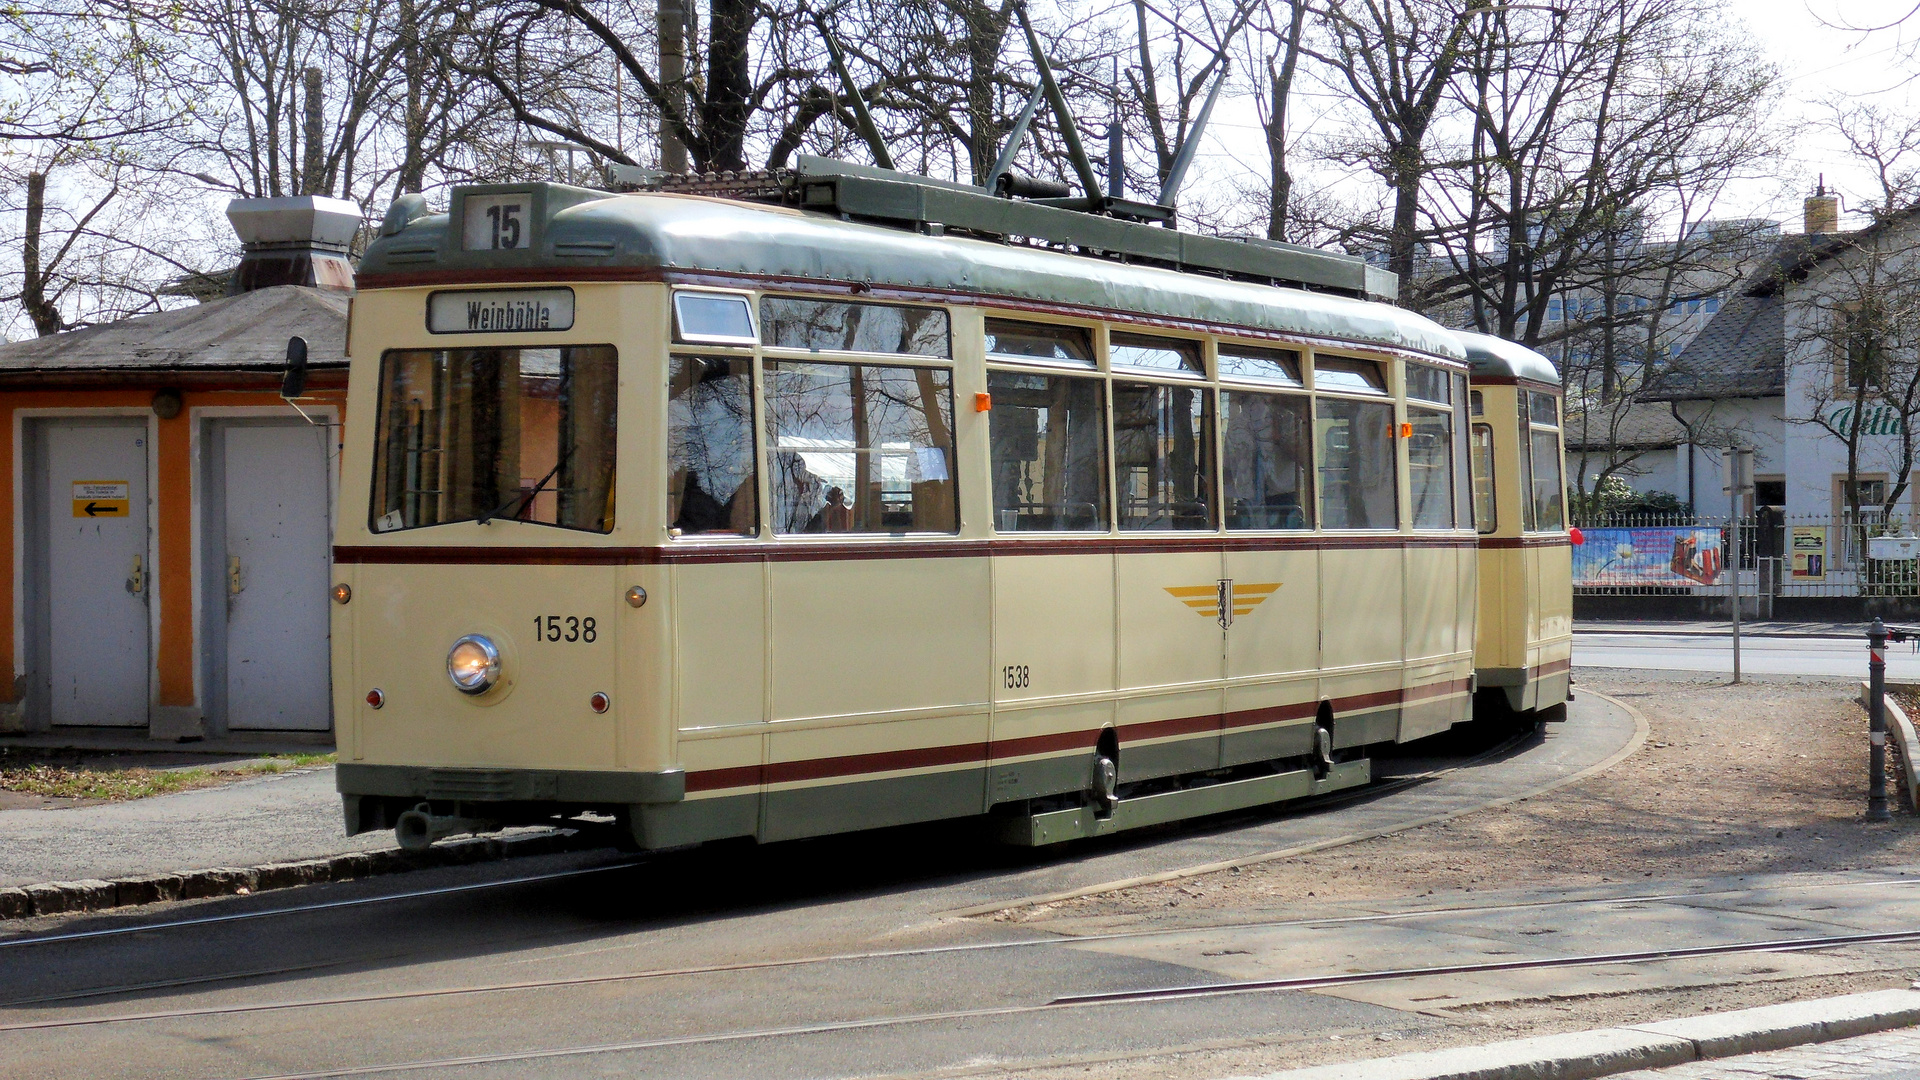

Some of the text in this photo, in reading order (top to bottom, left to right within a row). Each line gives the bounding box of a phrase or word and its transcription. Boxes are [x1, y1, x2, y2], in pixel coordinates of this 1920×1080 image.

[486, 204, 521, 250] 15
[467, 301, 550, 330] Weinböhla
[385, 514, 394, 528] 2
[534, 615, 597, 643] 1538
[1002, 665, 1030, 689] 1538
